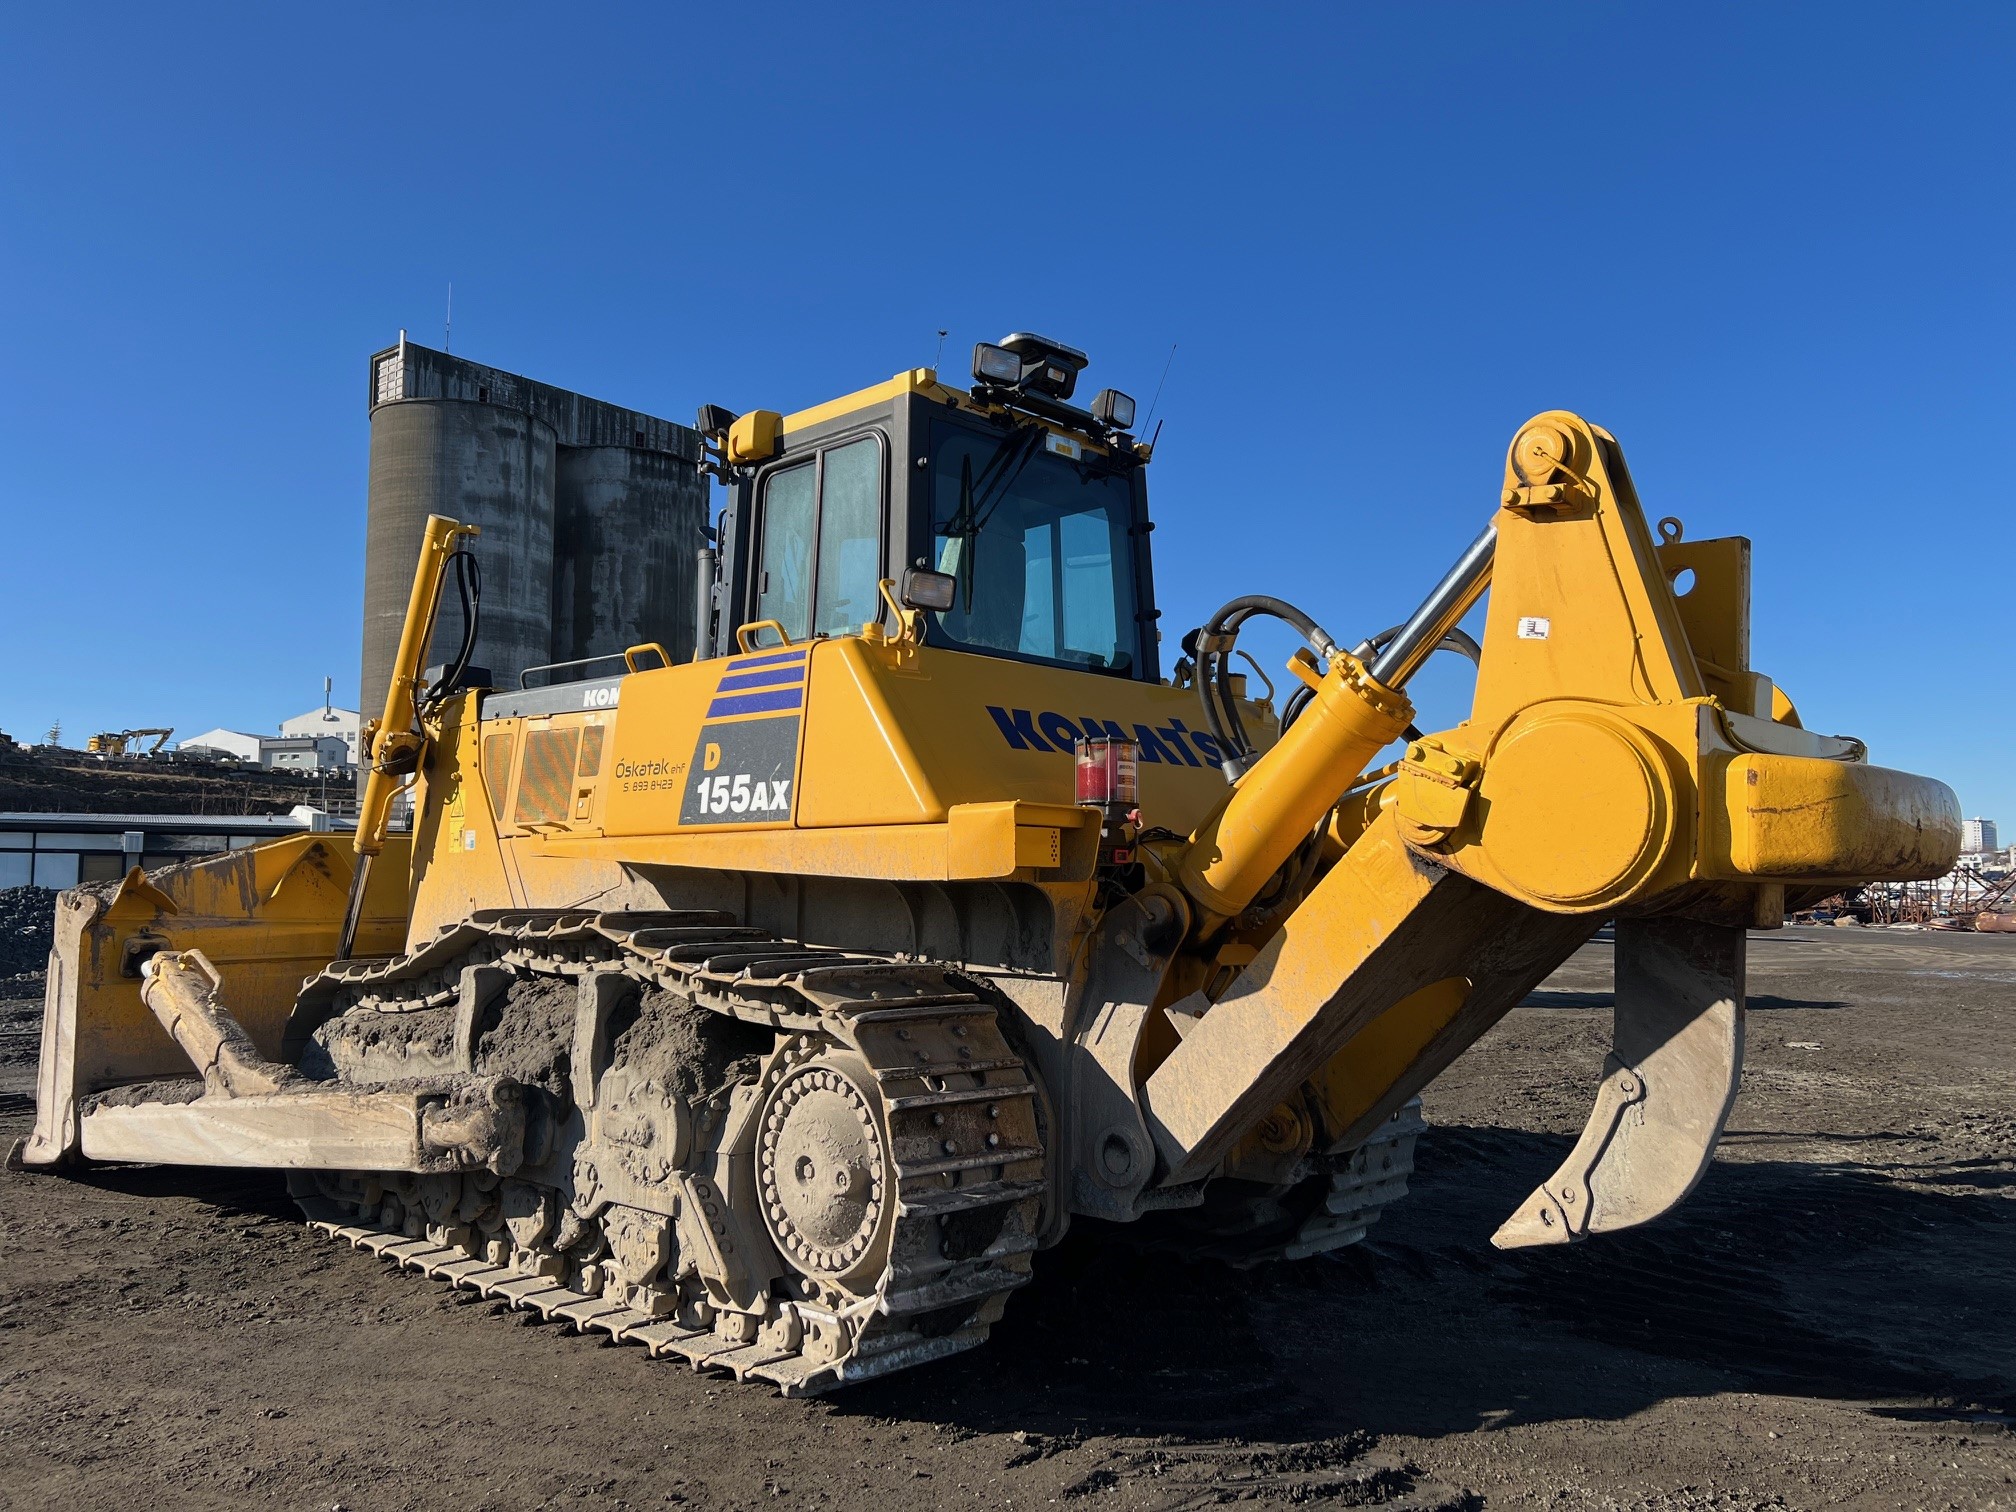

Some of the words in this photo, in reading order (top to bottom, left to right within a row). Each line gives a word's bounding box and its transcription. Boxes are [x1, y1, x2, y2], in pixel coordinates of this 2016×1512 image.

[615, 757, 669, 779] Óskatak
[670, 762, 686, 775] ehf
[703, 742, 721, 771] D
[632, 780, 649, 792] 893
[650, 778, 673, 791] 8423
[697, 773, 791, 815] 155AX
